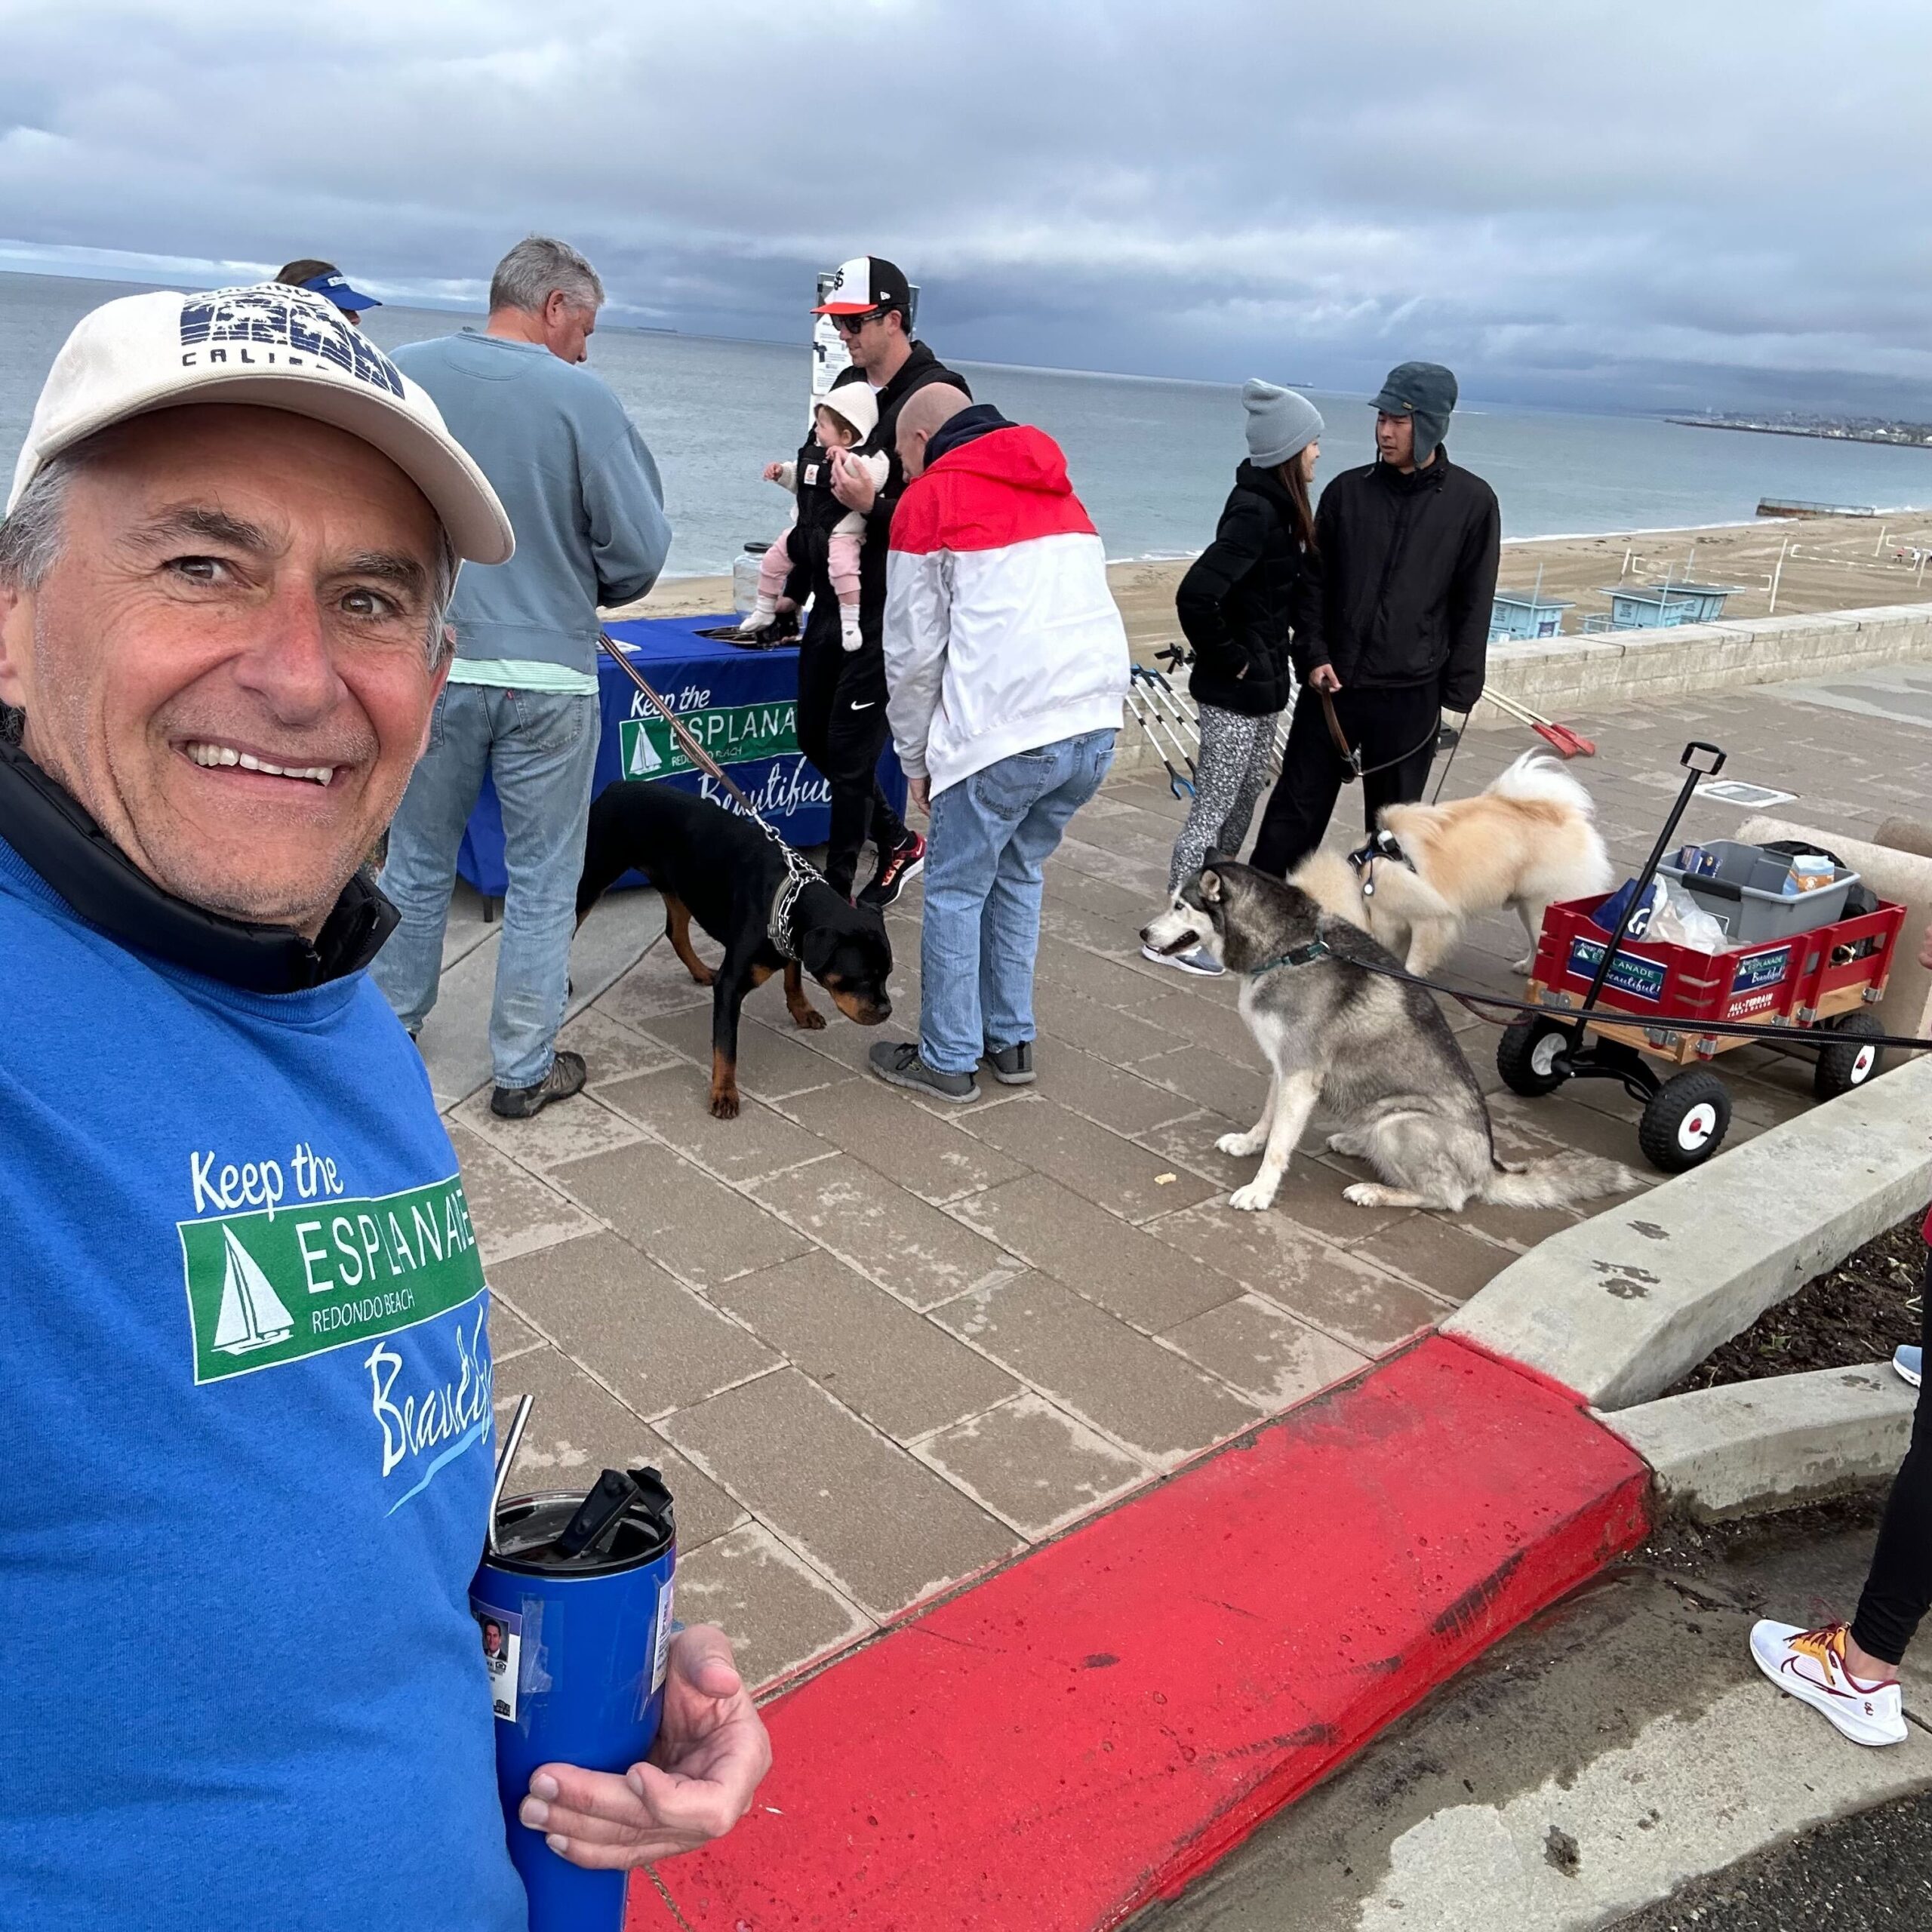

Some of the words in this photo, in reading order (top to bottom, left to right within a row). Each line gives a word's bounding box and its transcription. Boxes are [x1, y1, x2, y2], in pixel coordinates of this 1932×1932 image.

[679, 685, 711, 711] the
[672, 750, 714, 768] REDO
[1592, 952, 1655, 979] ESLANADE
[190, 1150, 284, 1222] Keep
[291, 1142, 344, 1198] the
[312, 1296, 383, 1334] REDONDO
[384, 1288, 415, 1315] BEACH
[364, 1303, 493, 1477] Beautif
